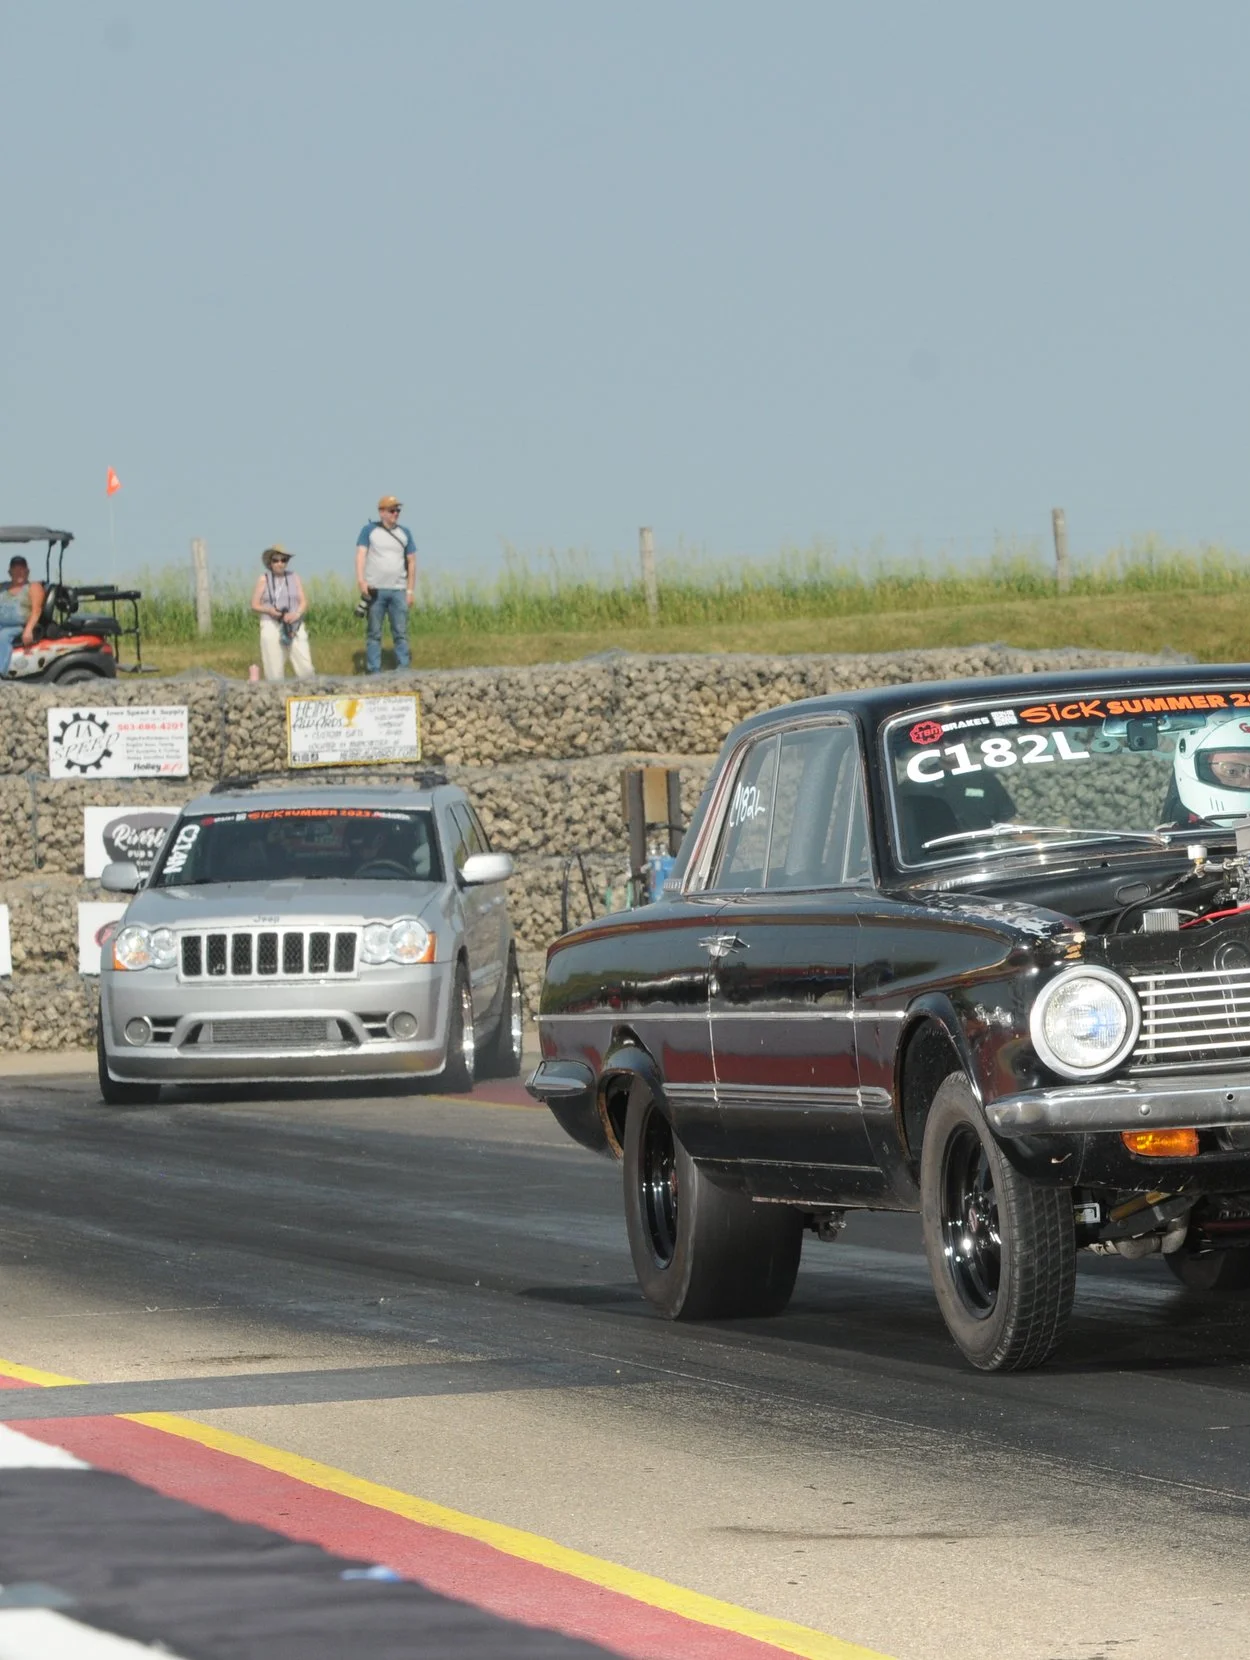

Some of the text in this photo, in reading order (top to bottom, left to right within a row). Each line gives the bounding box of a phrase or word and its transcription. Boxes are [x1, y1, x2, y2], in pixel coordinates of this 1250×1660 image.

[1106, 694, 1228, 715] SUMMER
[941, 716, 990, 732] BRAKES
[906, 731, 1090, 783] C182L
[252, 915, 281, 923] Jeep
